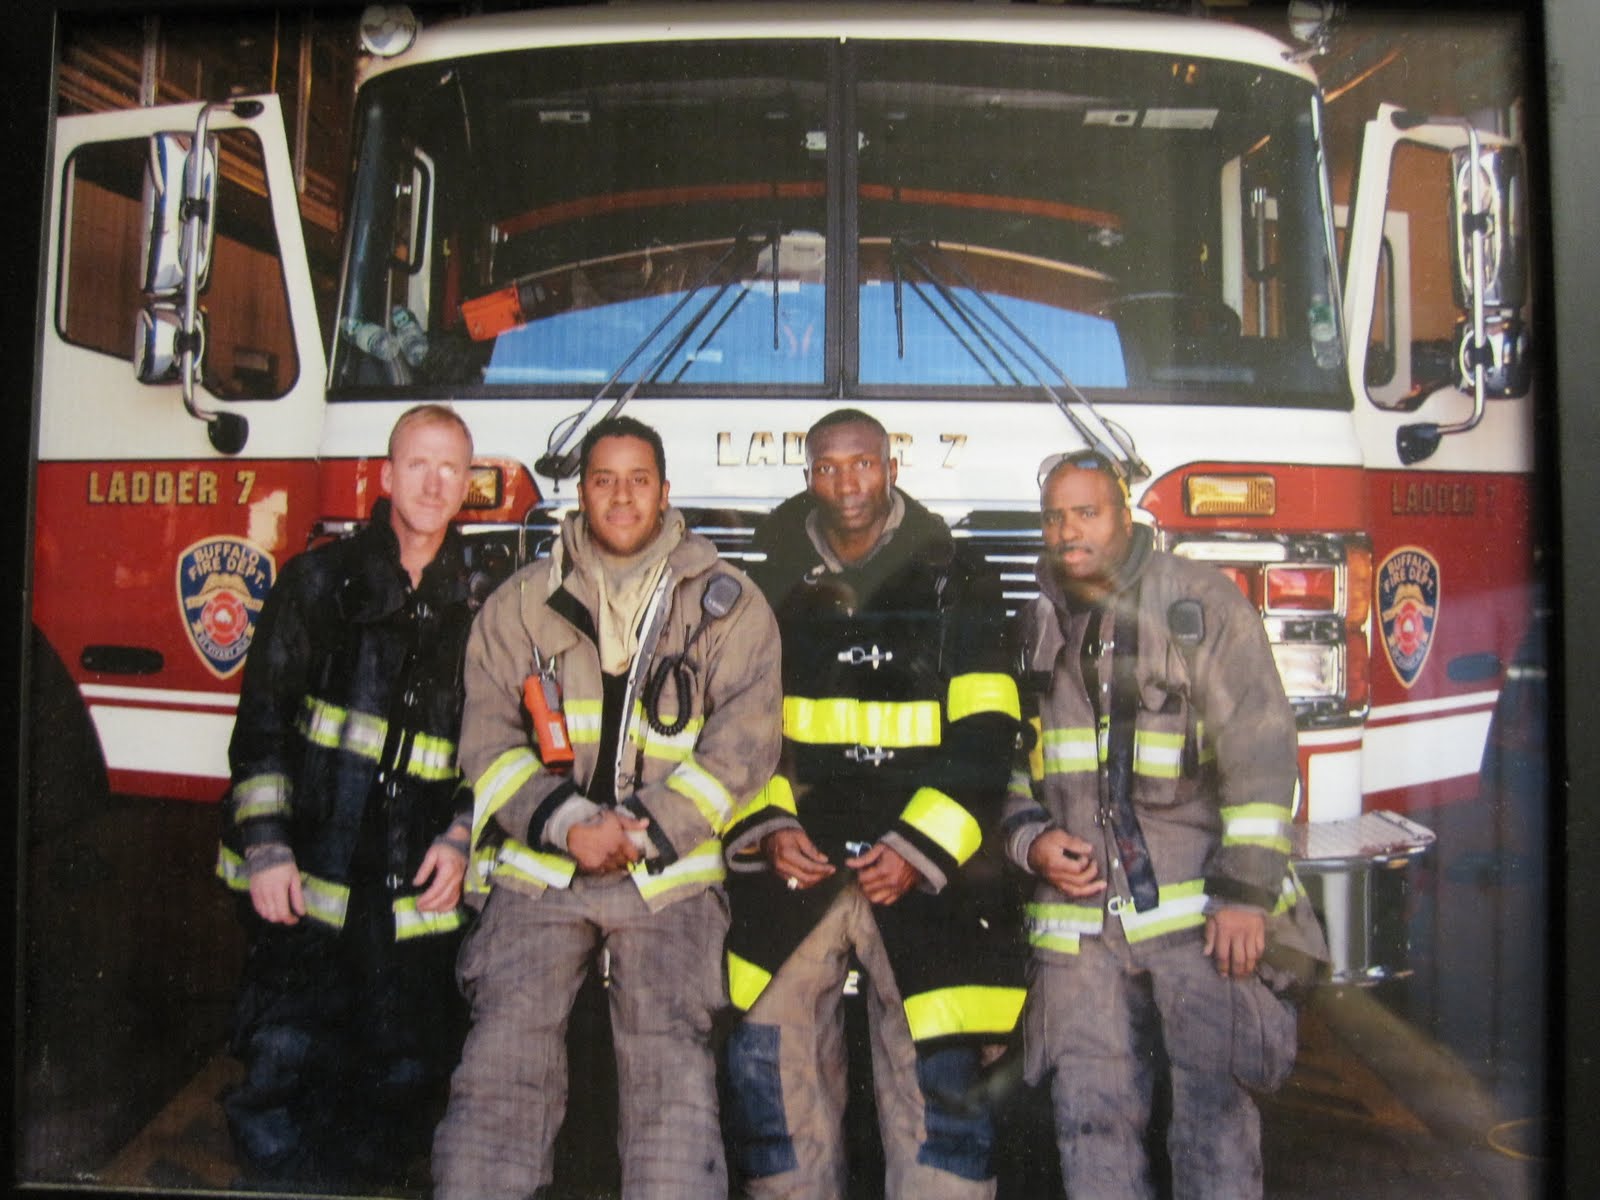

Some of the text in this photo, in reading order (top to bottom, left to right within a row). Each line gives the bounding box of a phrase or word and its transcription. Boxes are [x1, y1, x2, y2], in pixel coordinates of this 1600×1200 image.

[939, 433, 967, 471] 7
[88, 471, 256, 504] LADDER 7
[1391, 482, 1475, 515] LADDER
[194, 543, 259, 566] BUFFALO
[1387, 553, 1430, 575] BUFFALO
[188, 557, 221, 582] FIRE
[1384, 568, 1406, 593] FIRE
